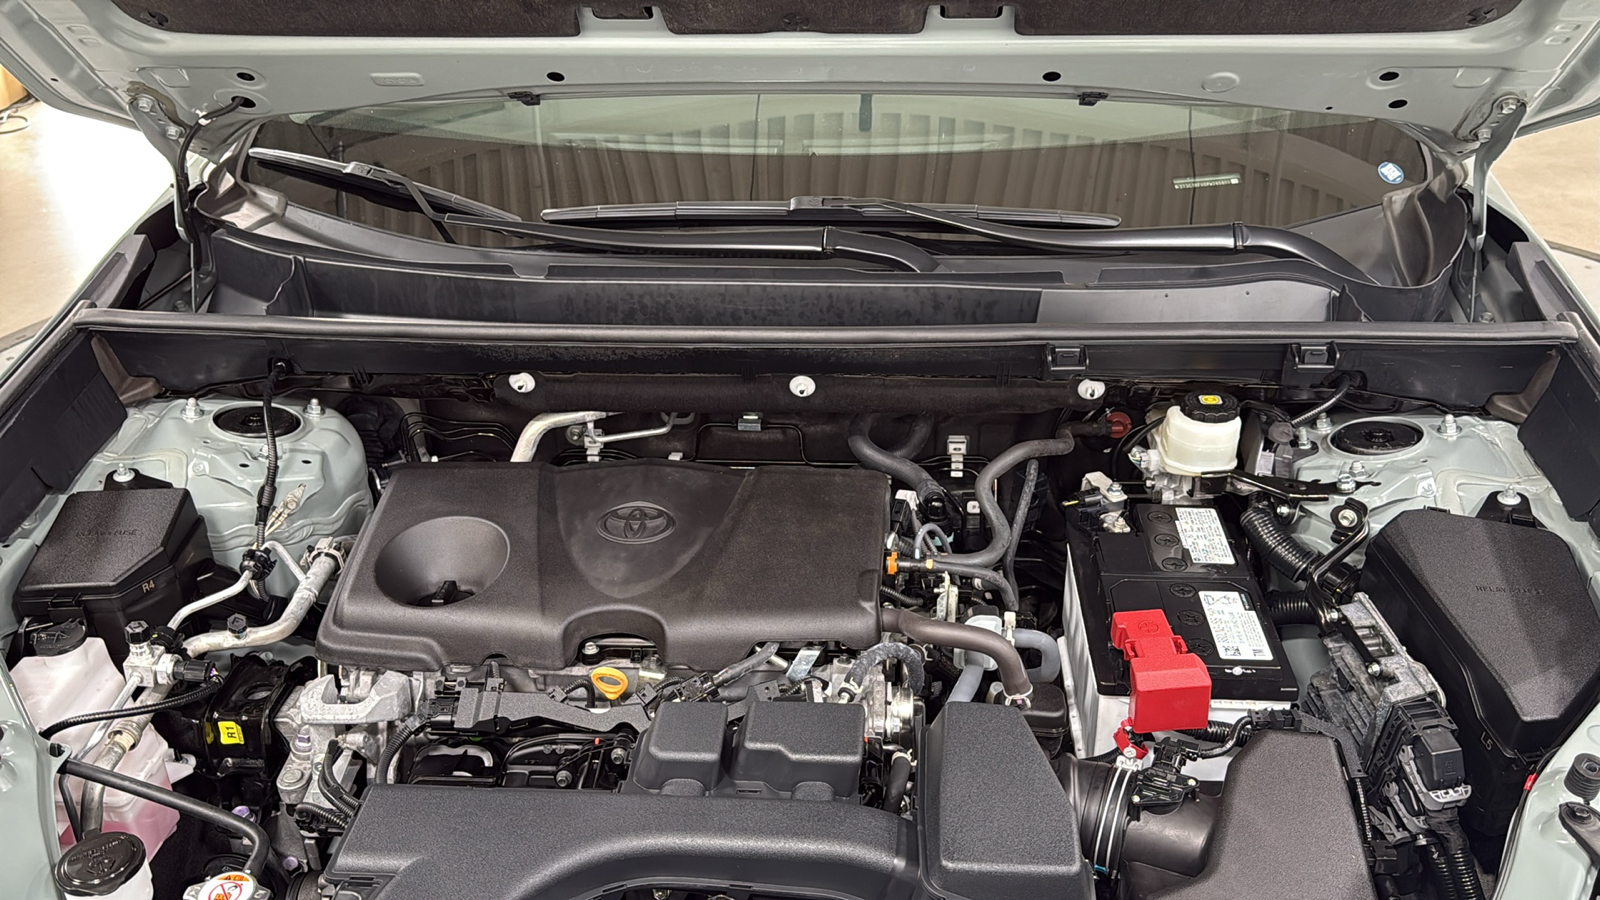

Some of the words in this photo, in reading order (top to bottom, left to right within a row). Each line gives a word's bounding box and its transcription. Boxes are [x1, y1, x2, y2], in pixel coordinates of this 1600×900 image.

[142, 580, 155, 594] R4
[225, 726, 237, 739] R1
[1480, 731, 1493, 751] L5
